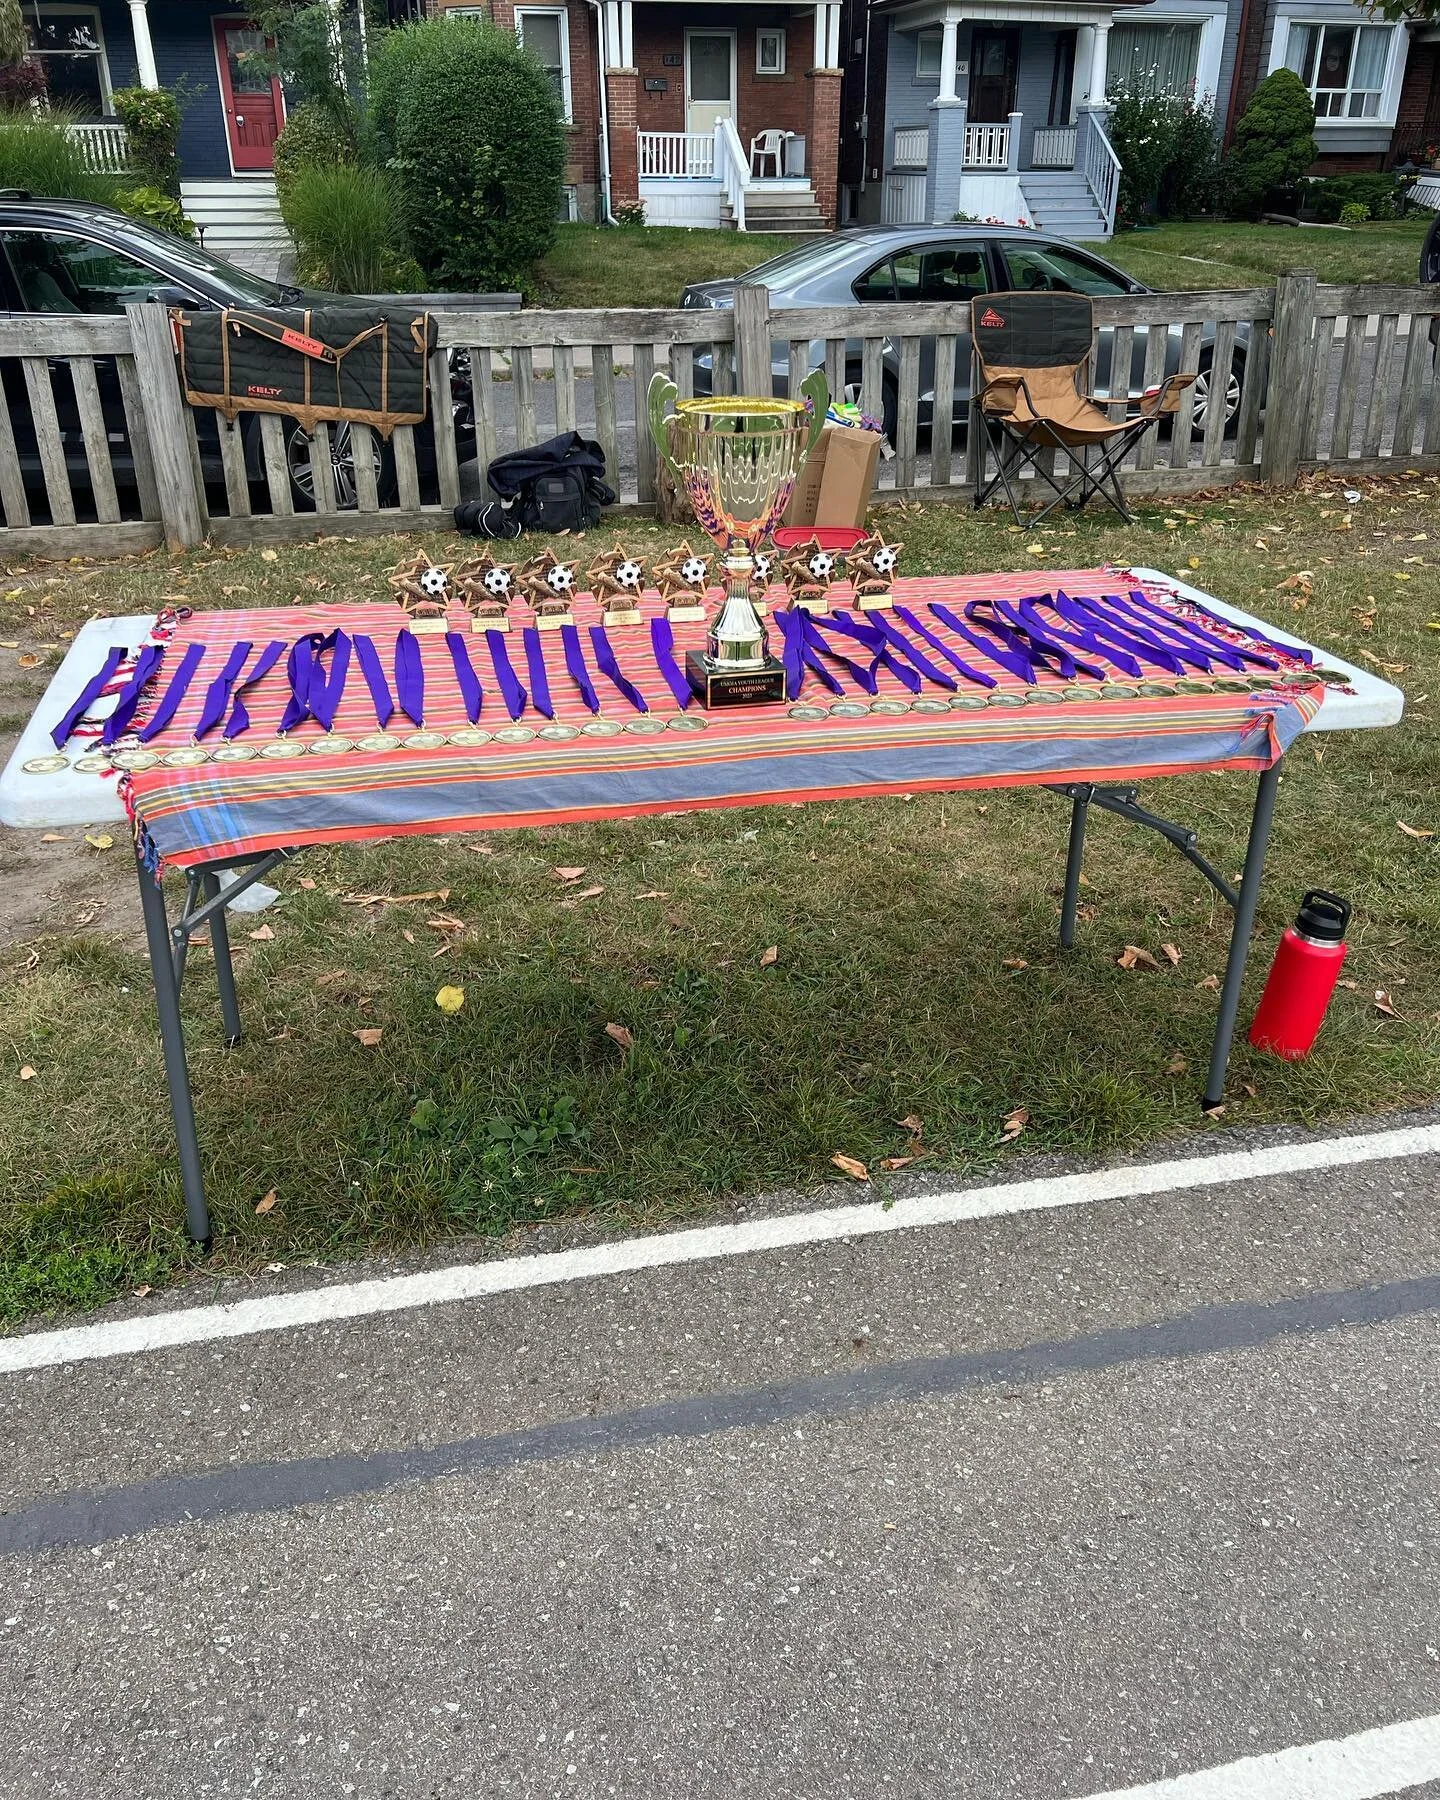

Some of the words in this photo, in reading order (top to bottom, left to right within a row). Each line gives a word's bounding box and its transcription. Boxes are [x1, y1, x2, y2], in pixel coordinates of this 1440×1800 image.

[288, 333, 318, 349] KELTY
[248, 386, 282, 395] KELTY
[729, 684, 766, 694] CHAMPIONS
